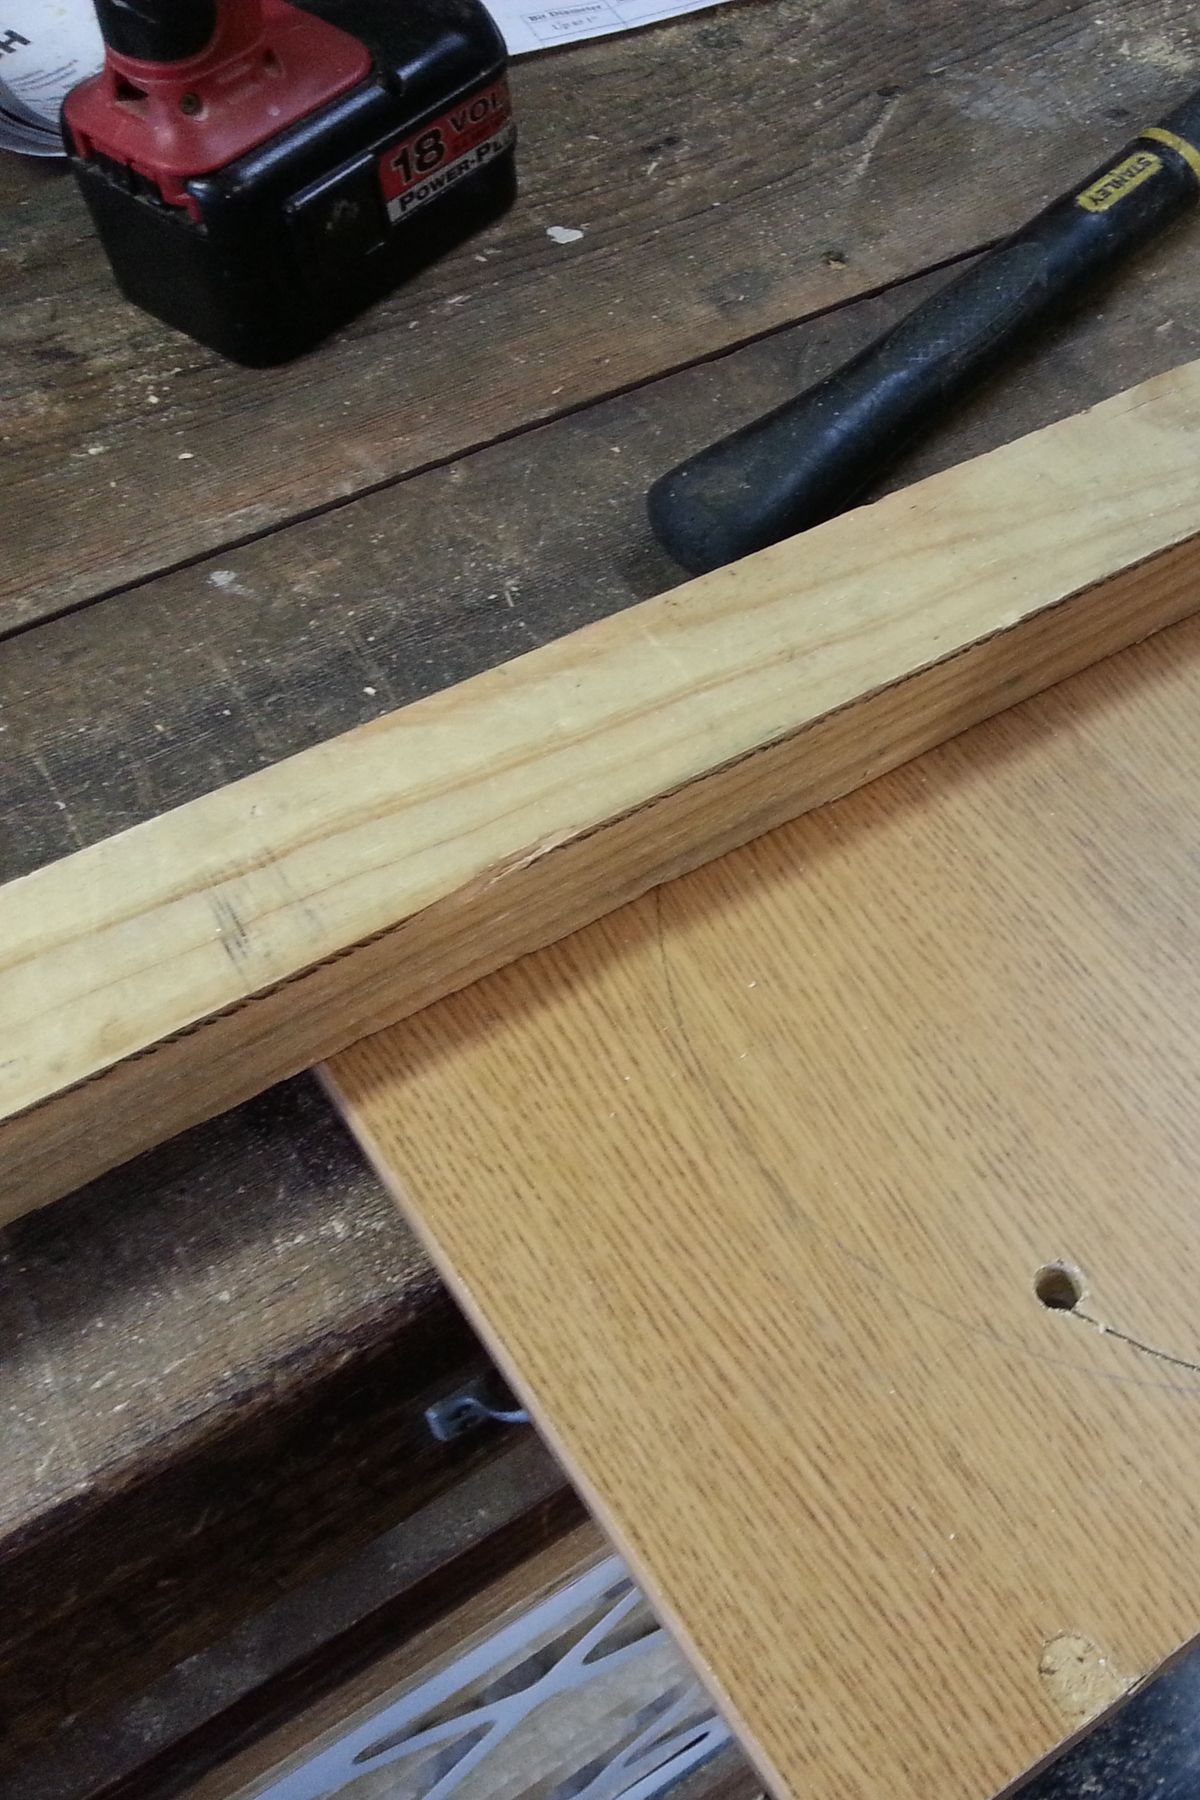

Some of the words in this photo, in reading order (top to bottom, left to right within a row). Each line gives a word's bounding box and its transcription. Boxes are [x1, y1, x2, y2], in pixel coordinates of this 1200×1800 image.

[392, 127, 446, 184] 18
[449, 92, 507, 133] VOL
[1088, 156, 1154, 207] STANLEY
